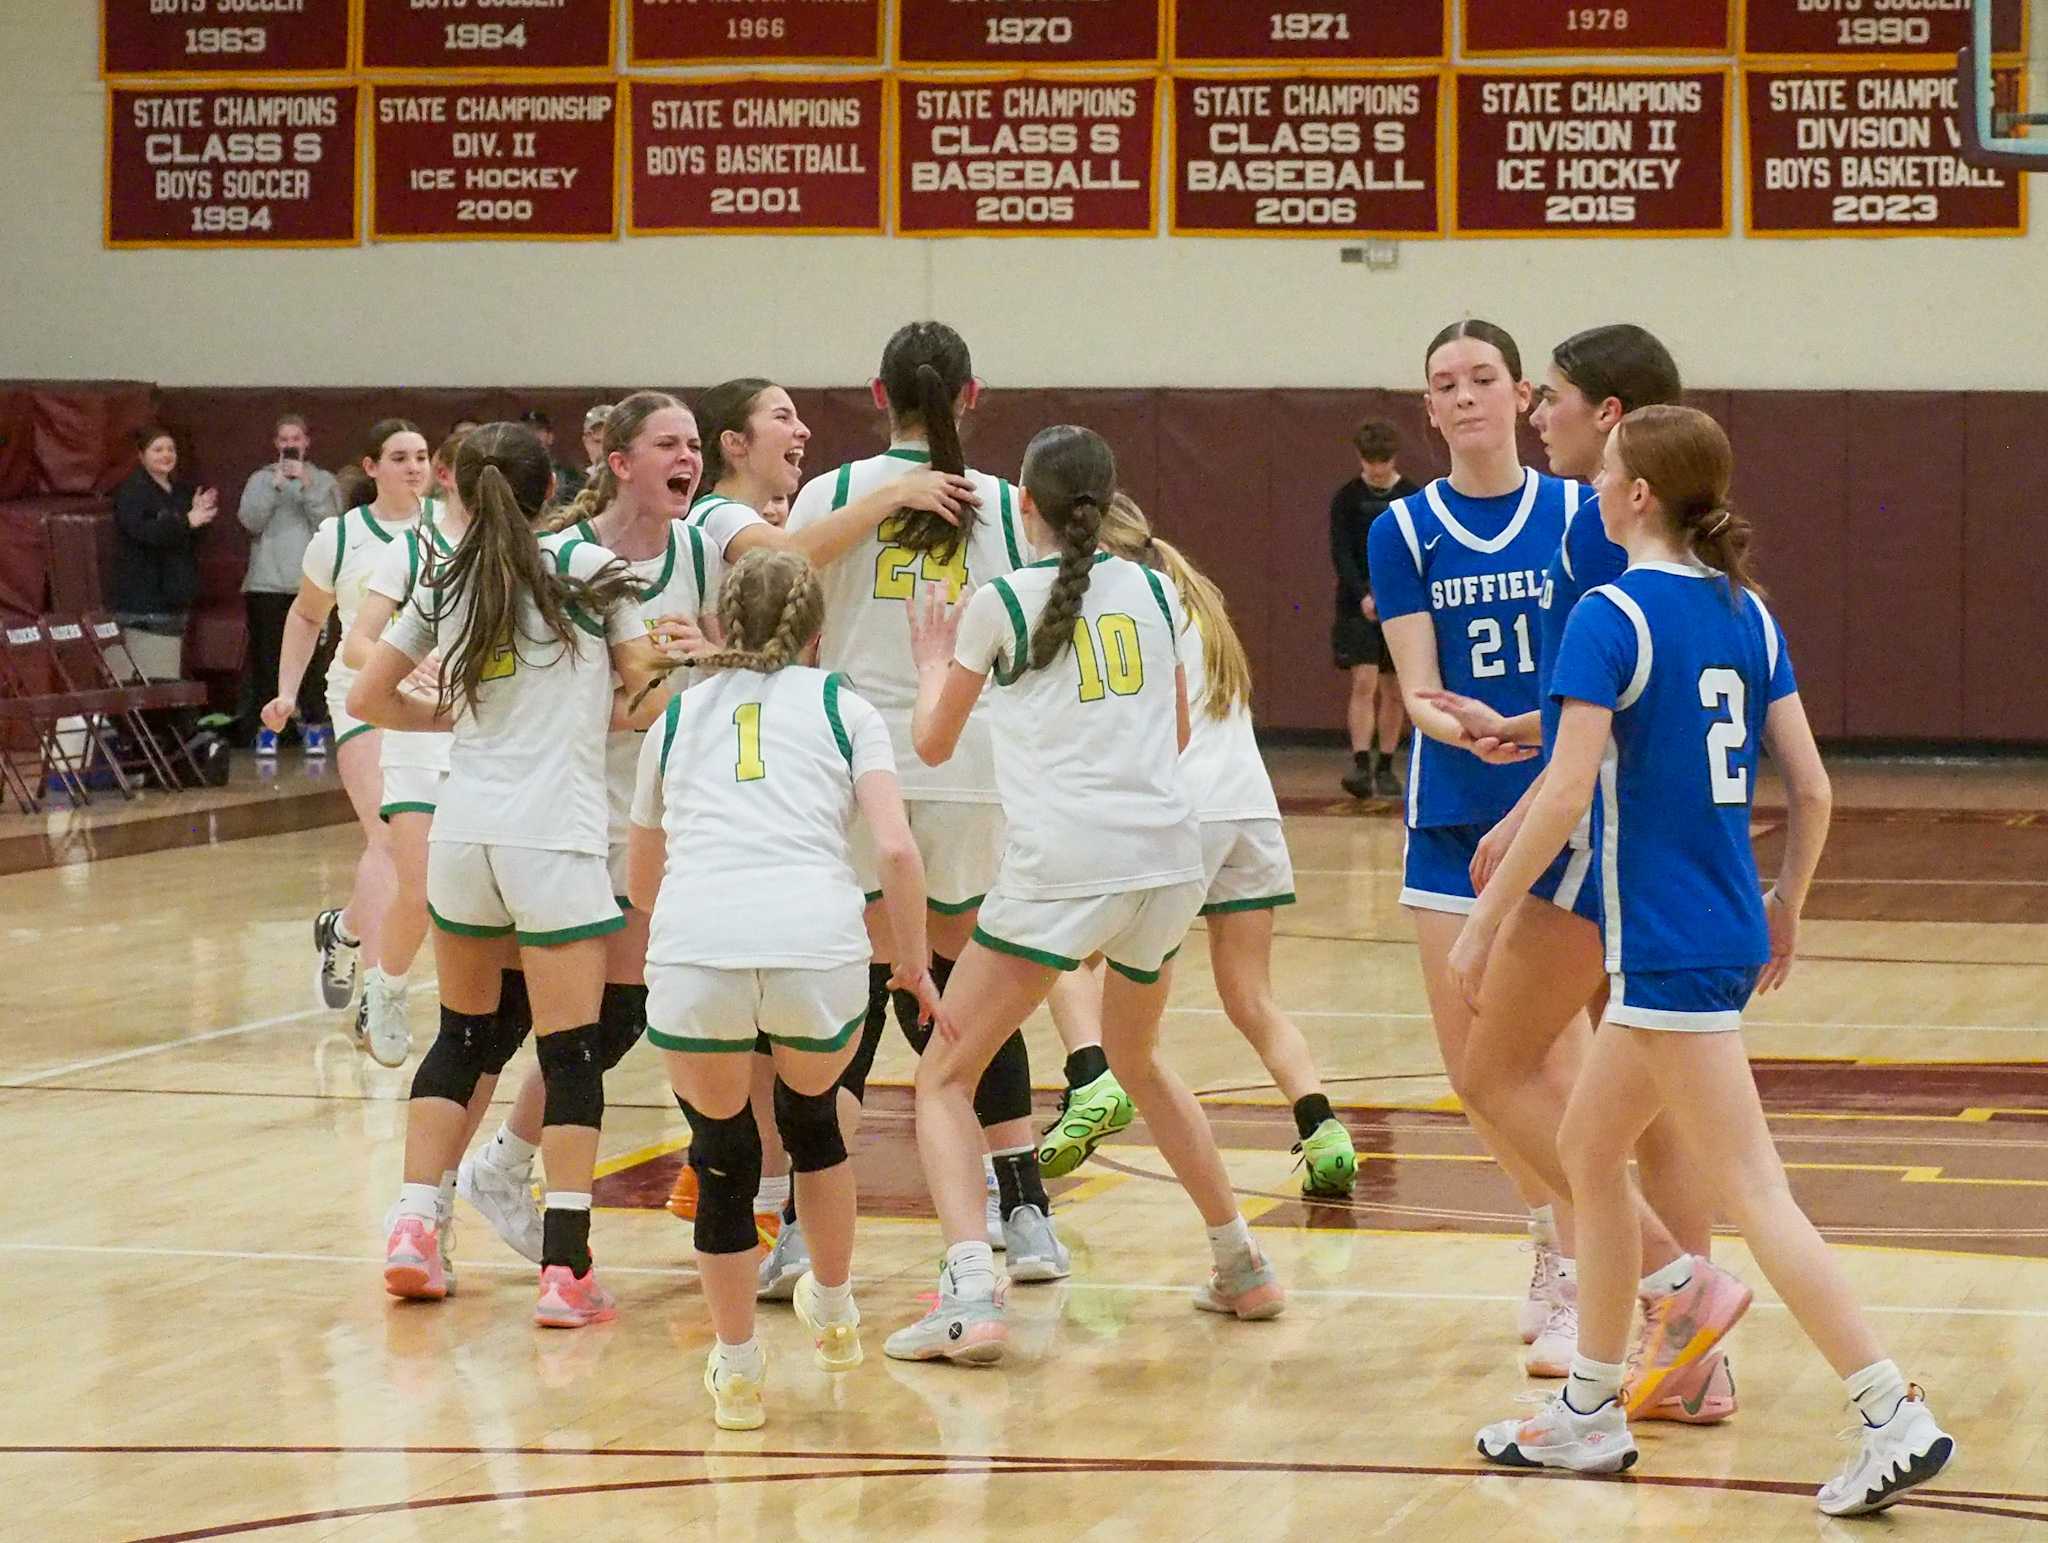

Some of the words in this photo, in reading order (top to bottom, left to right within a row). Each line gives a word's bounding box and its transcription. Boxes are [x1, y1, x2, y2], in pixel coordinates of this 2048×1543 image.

[728, 18, 786, 40] 1966
[987, 18, 1073, 45] 1970
[1272, 14, 1350, 40] 1971
[1567, 9, 1629, 31] 1978
[1839, 18, 1930, 45] 1990
[186, 29, 267, 53] 1963
[446, 25, 527, 50] 1964
[381, 99, 447, 123] STATE
[457, 97, 613, 122] CHAMPIONSHIP
[918, 90, 993, 121] STATE
[1005, 88, 1137, 119] CHAMPIONS
[1194, 87, 1272, 117] STATE
[1285, 85, 1420, 117] CHAMPIONS
[1483, 83, 1562, 115] STATE
[1572, 82, 1702, 114] CHAMPIONS
[1771, 80, 1848, 112] STATE
[1858, 78, 1960, 111] CHAMPIO
[135, 99, 204, 128] STATE
[215, 98, 338, 127] CHAMPIONS
[653, 100, 723, 130] STATE
[734, 99, 861, 129] CHAMPIONS
[146, 134, 283, 164] CLASS
[294, 134, 323, 163] S
[454, 134, 503, 158] DIV.
[514, 133, 536, 158] II
[932, 125, 1079, 156] CLASS
[1091, 125, 1121, 155] S
[1210, 123, 1362, 155] CLASS
[1375, 122, 1406, 154] S
[1508, 120, 1633, 153] DIVISION
[1649, 120, 1678, 152] II
[1798, 117, 1932, 151] DIVISION
[647, 146, 706, 176] BOYS
[717, 144, 866, 175] BASKETBALL
[1766, 158, 1832, 191] BOYS
[1842, 156, 2006, 189] BASKETBALL
[156, 171, 213, 200] BOYS
[224, 170, 311, 200] SOCCER
[412, 170, 456, 190] ICE
[466, 169, 578, 190] HOCKEY
[912, 160, 1141, 192] BASEBALL
[1188, 160, 1426, 192] BASEBALL
[1498, 160, 1547, 192] ICE
[1558, 159, 1682, 191] HOCKEY
[458, 201, 533, 221] 2000
[711, 188, 802, 214] 2001
[977, 197, 1075, 223] 2005
[1257, 198, 1358, 225] 2006
[1546, 196, 1637, 223] 2015
[1833, 195, 1939, 223] 2023
[192, 207, 272, 232] 1994
[1431, 569, 1548, 611] SUFFIEL
[1072, 612, 1145, 703] 10
[1467, 612, 1536, 679] 21
[731, 702, 766, 782] 1
[1698, 667, 1748, 804] 2
